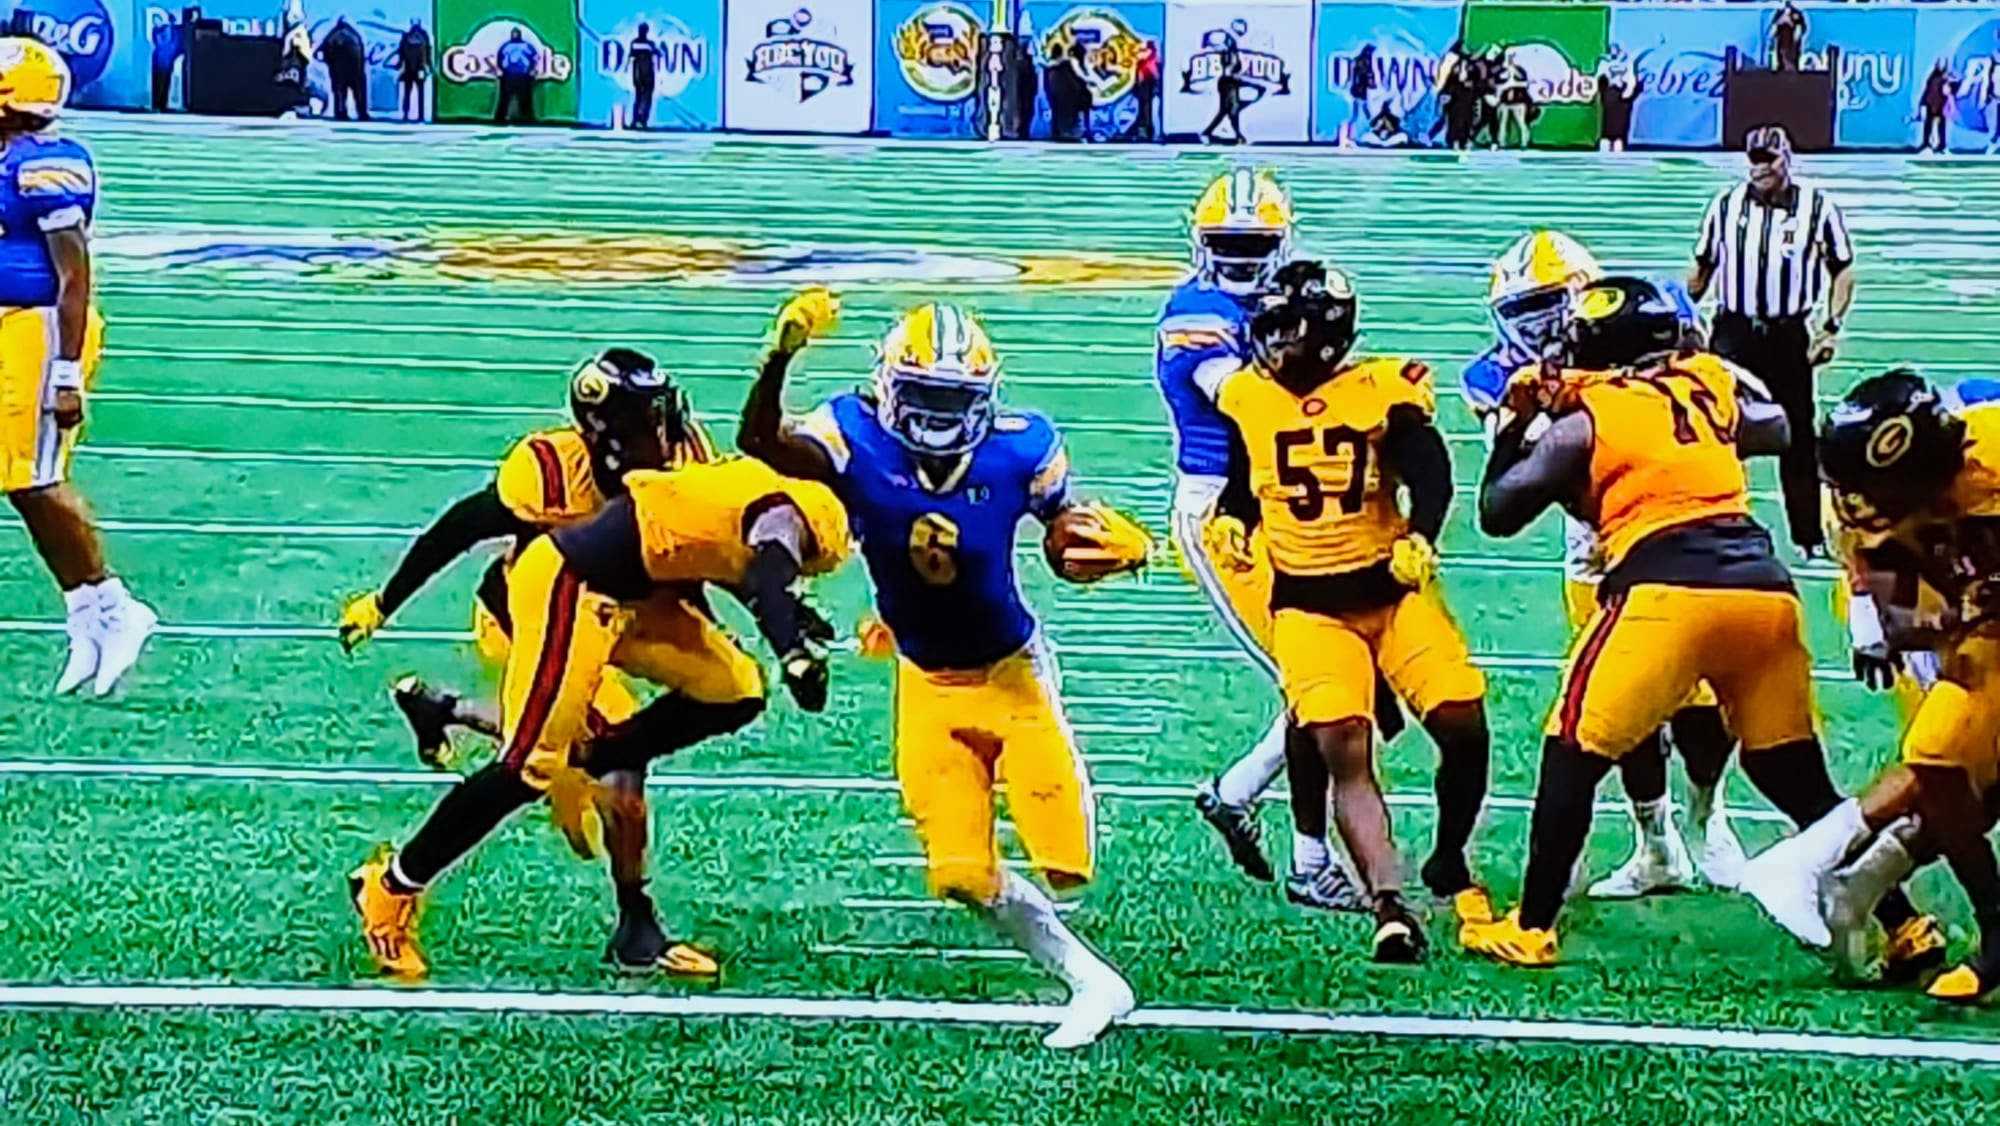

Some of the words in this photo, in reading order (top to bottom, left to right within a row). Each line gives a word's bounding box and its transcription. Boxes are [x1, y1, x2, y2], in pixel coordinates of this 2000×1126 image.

[602, 40, 702, 73] DWN
[1333, 56, 1435, 94] DWN
[1275, 424, 1367, 521] 57
[909, 512, 959, 585] 6
